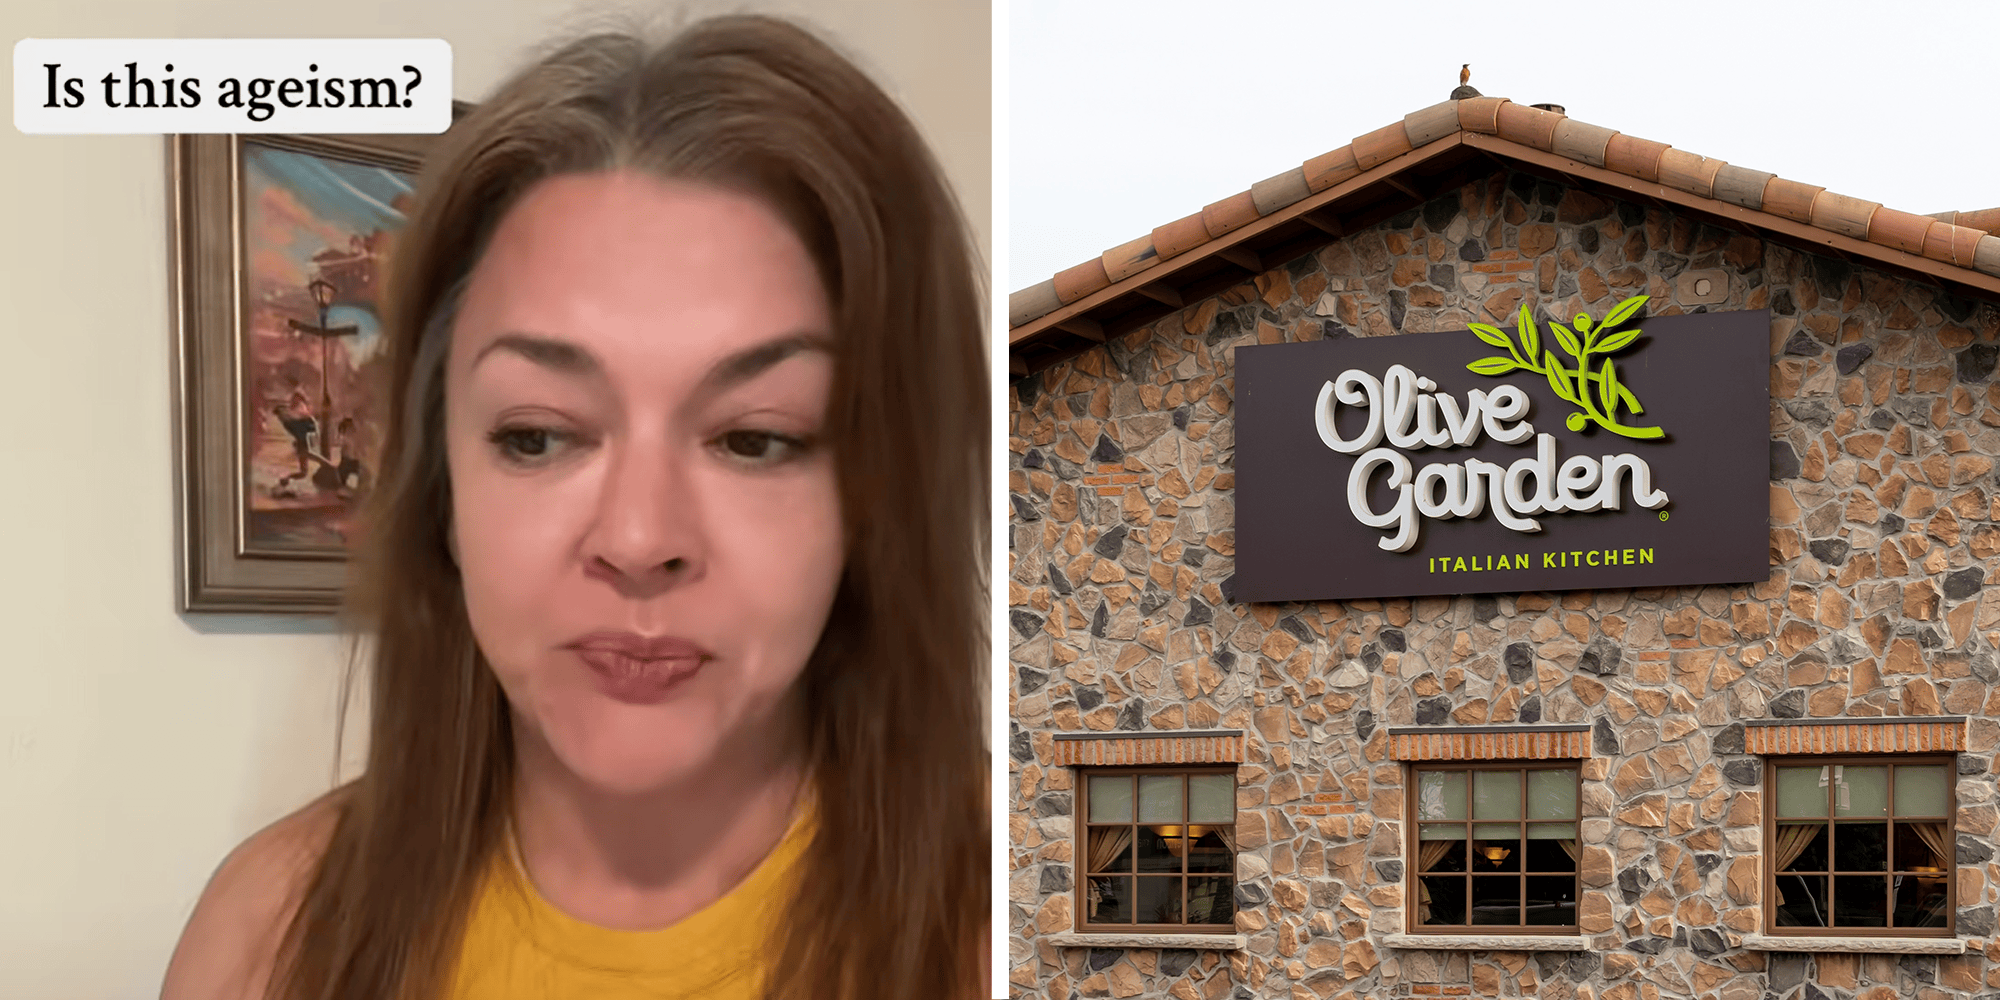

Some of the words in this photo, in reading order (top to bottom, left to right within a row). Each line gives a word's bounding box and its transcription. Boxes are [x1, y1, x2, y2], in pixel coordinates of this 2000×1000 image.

[1315, 364, 1534, 454] Olive
[1347, 432, 1669, 553] Garden
[1429, 553, 1530, 574] ITALIAN
[1543, 547, 1655, 569] KITCHEN
